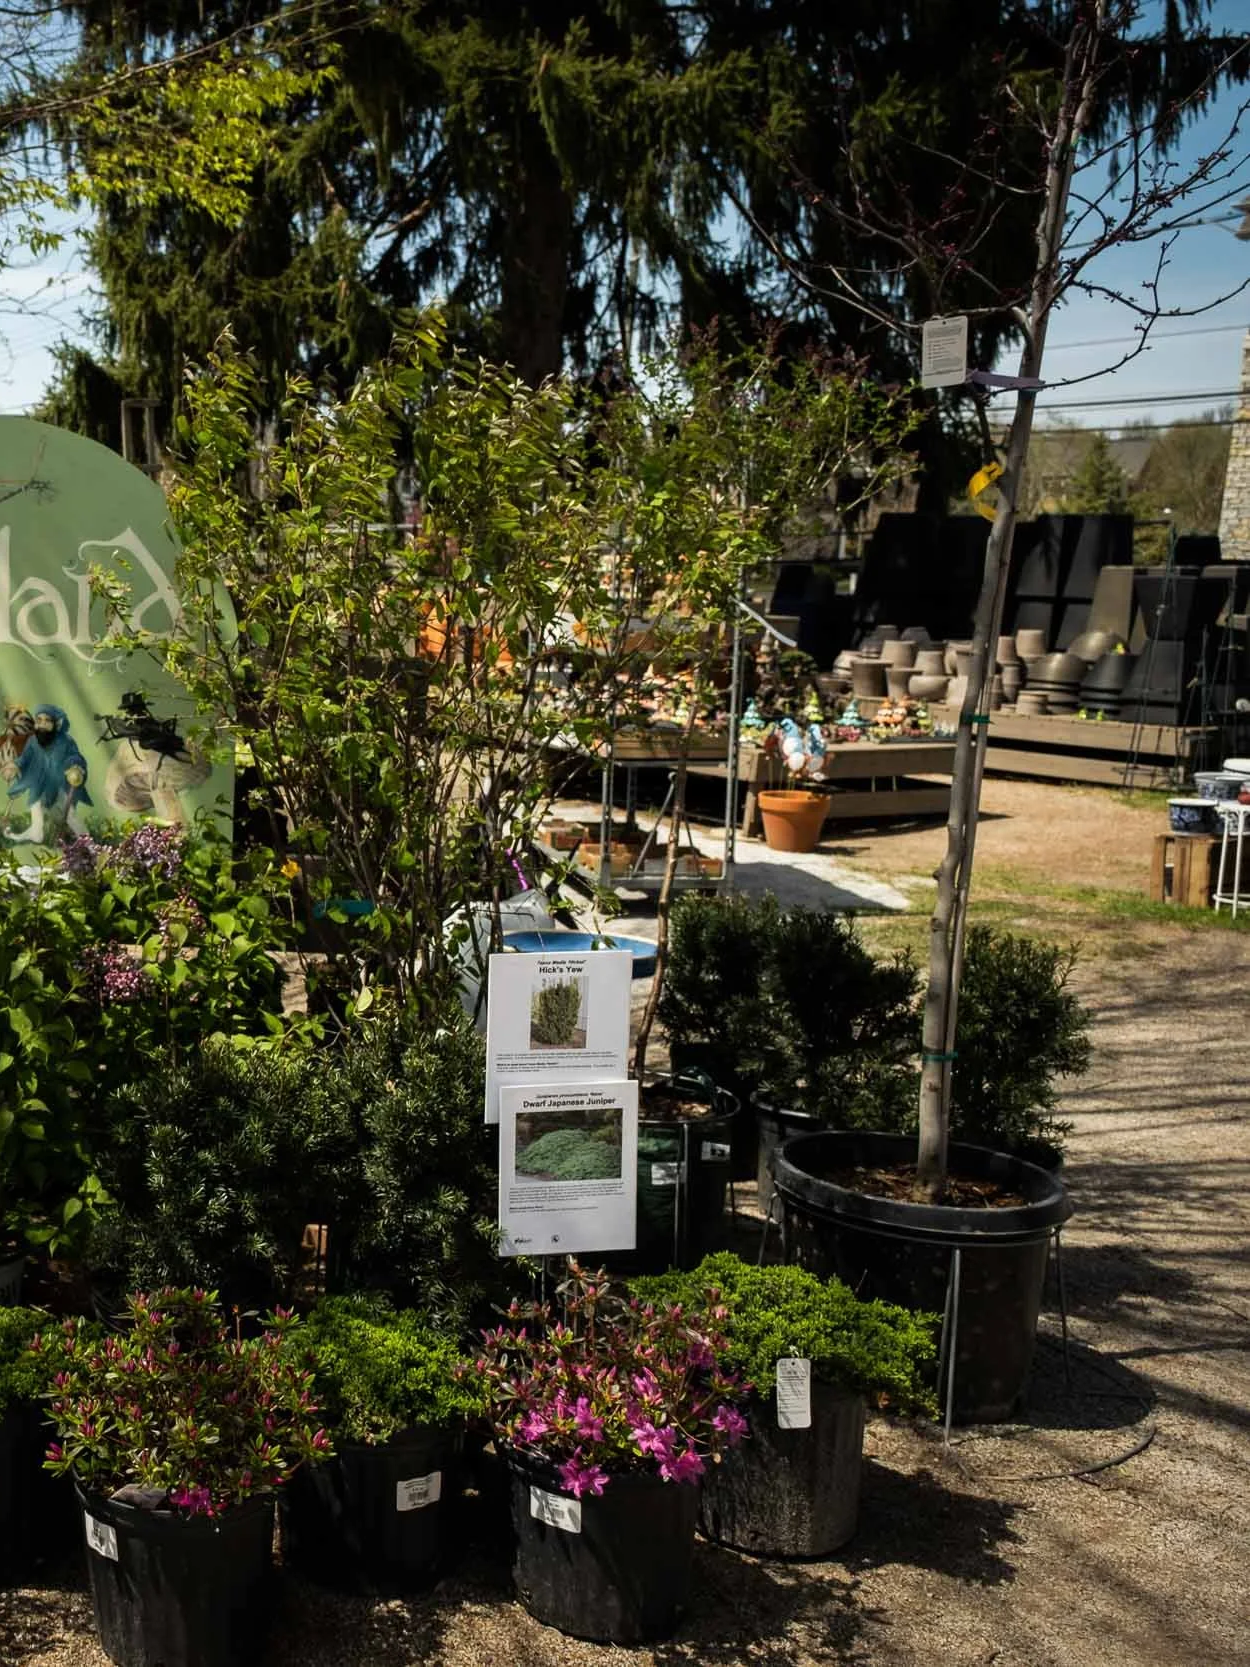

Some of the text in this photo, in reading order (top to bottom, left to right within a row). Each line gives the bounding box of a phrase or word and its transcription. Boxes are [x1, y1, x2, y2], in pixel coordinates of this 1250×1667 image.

[539, 966, 564, 974] Hick's
[523, 1097, 616, 1108] Dwarf Japanese Juniper
